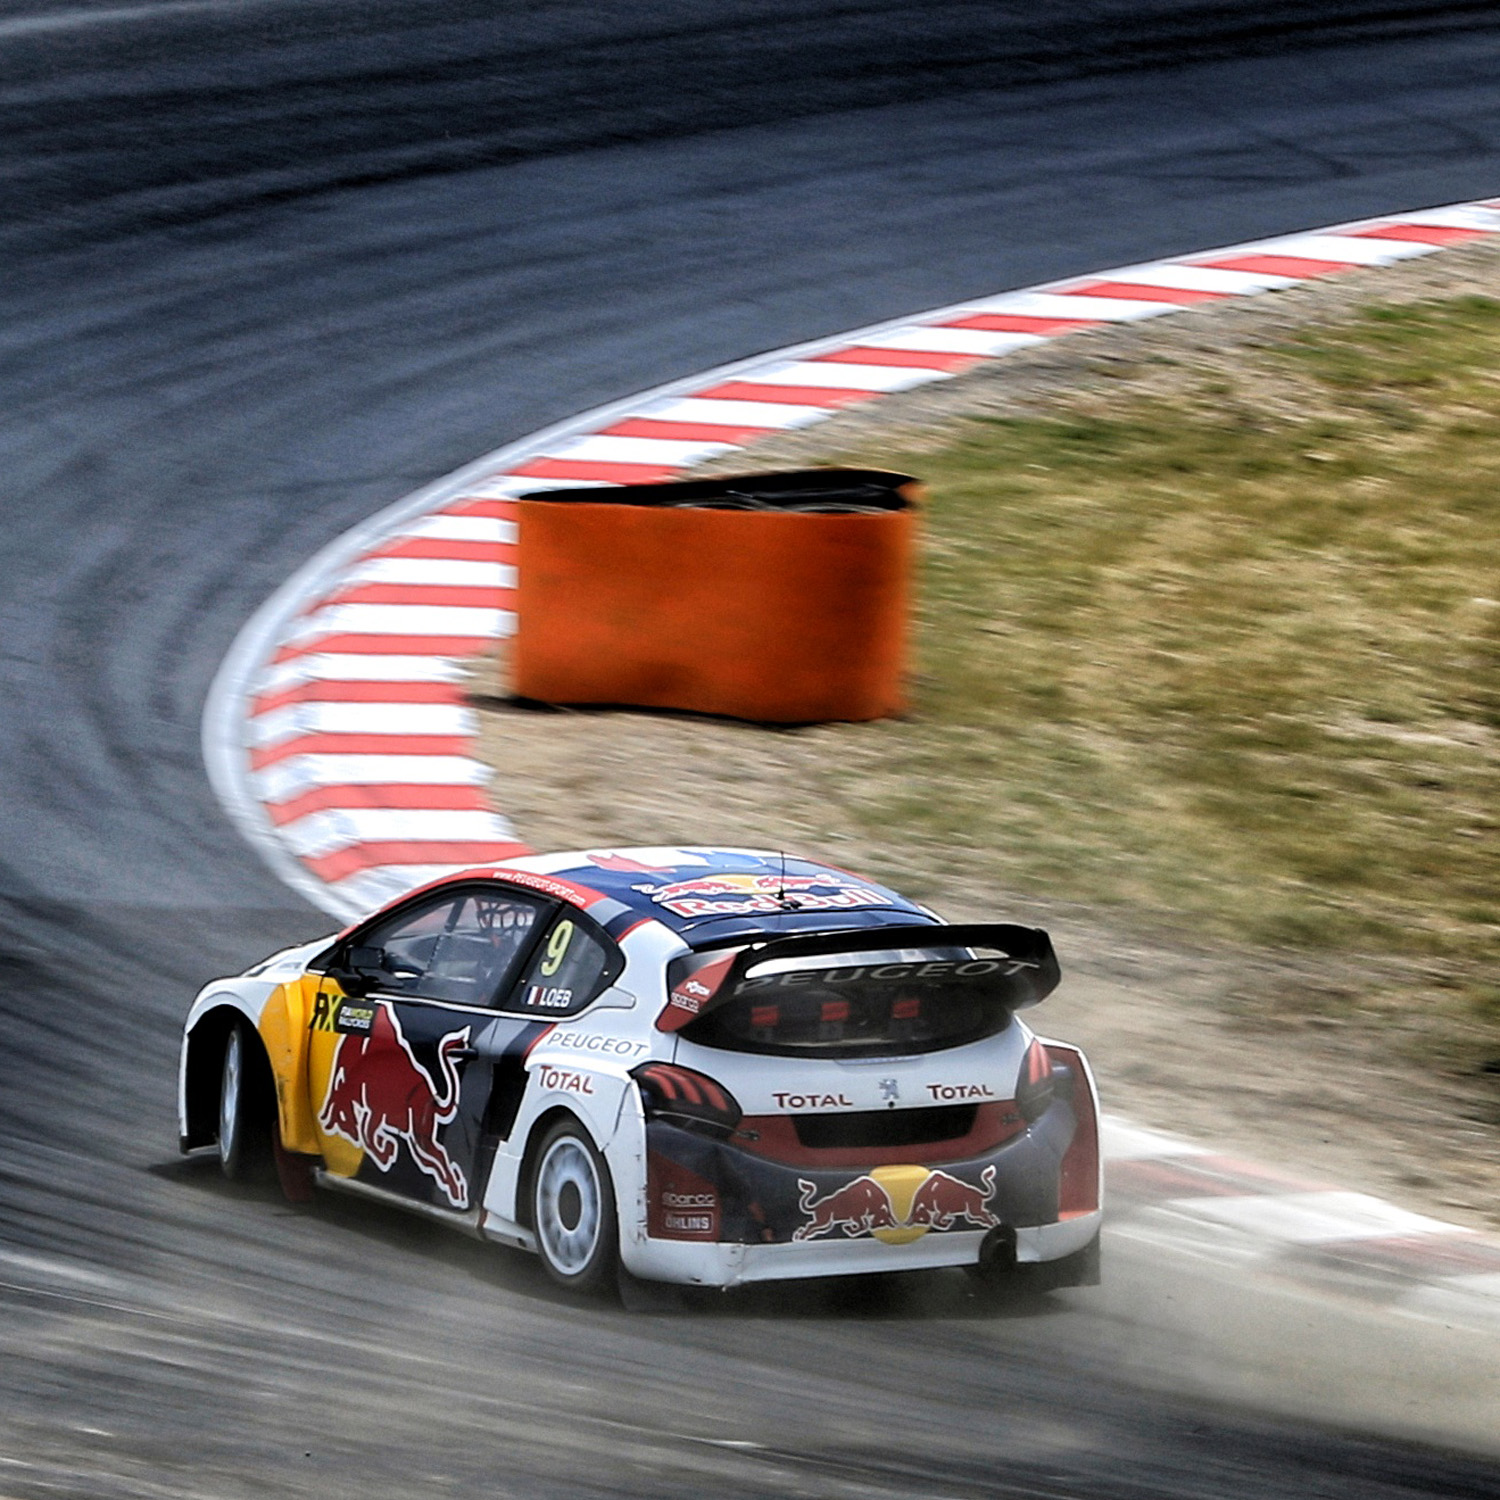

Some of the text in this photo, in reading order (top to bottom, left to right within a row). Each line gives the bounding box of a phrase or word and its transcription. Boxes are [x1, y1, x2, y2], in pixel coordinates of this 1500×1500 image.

[540, 919, 574, 977] 9
[733, 960, 1040, 996] PEUGEOT
[538, 987, 573, 1008] LOEB
[546, 1031, 649, 1057] PEUGEOT
[538, 1064, 594, 1095] TOTAL
[926, 1083, 995, 1101] TOTAL
[772, 1092, 853, 1109] TOTAL
